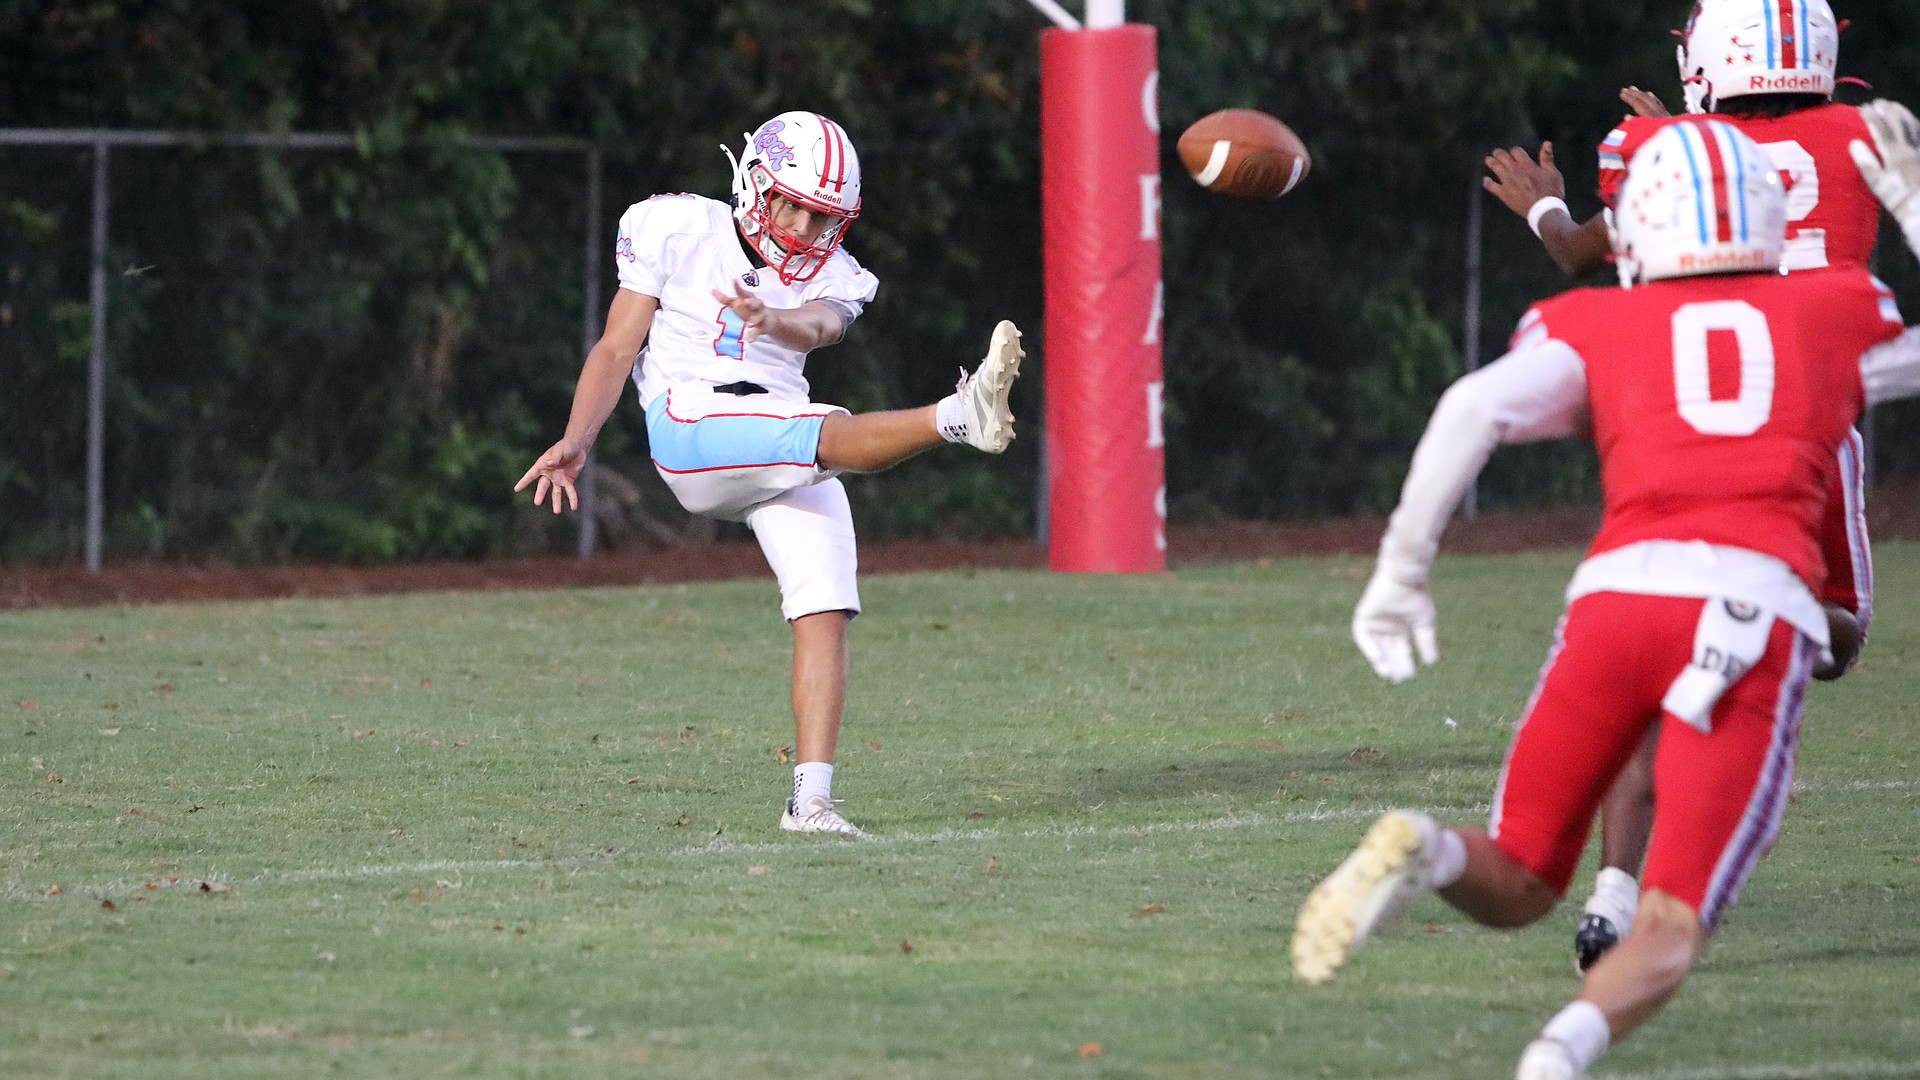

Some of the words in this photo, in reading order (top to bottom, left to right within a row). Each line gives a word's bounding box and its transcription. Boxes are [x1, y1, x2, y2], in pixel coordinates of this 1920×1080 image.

[1749, 74, 1823, 91] Riddell
[753, 119, 795, 172] Rock
[813, 189, 843, 205] Riddell
[713, 305, 746, 361] 1
[1671, 300, 1775, 437] 0
